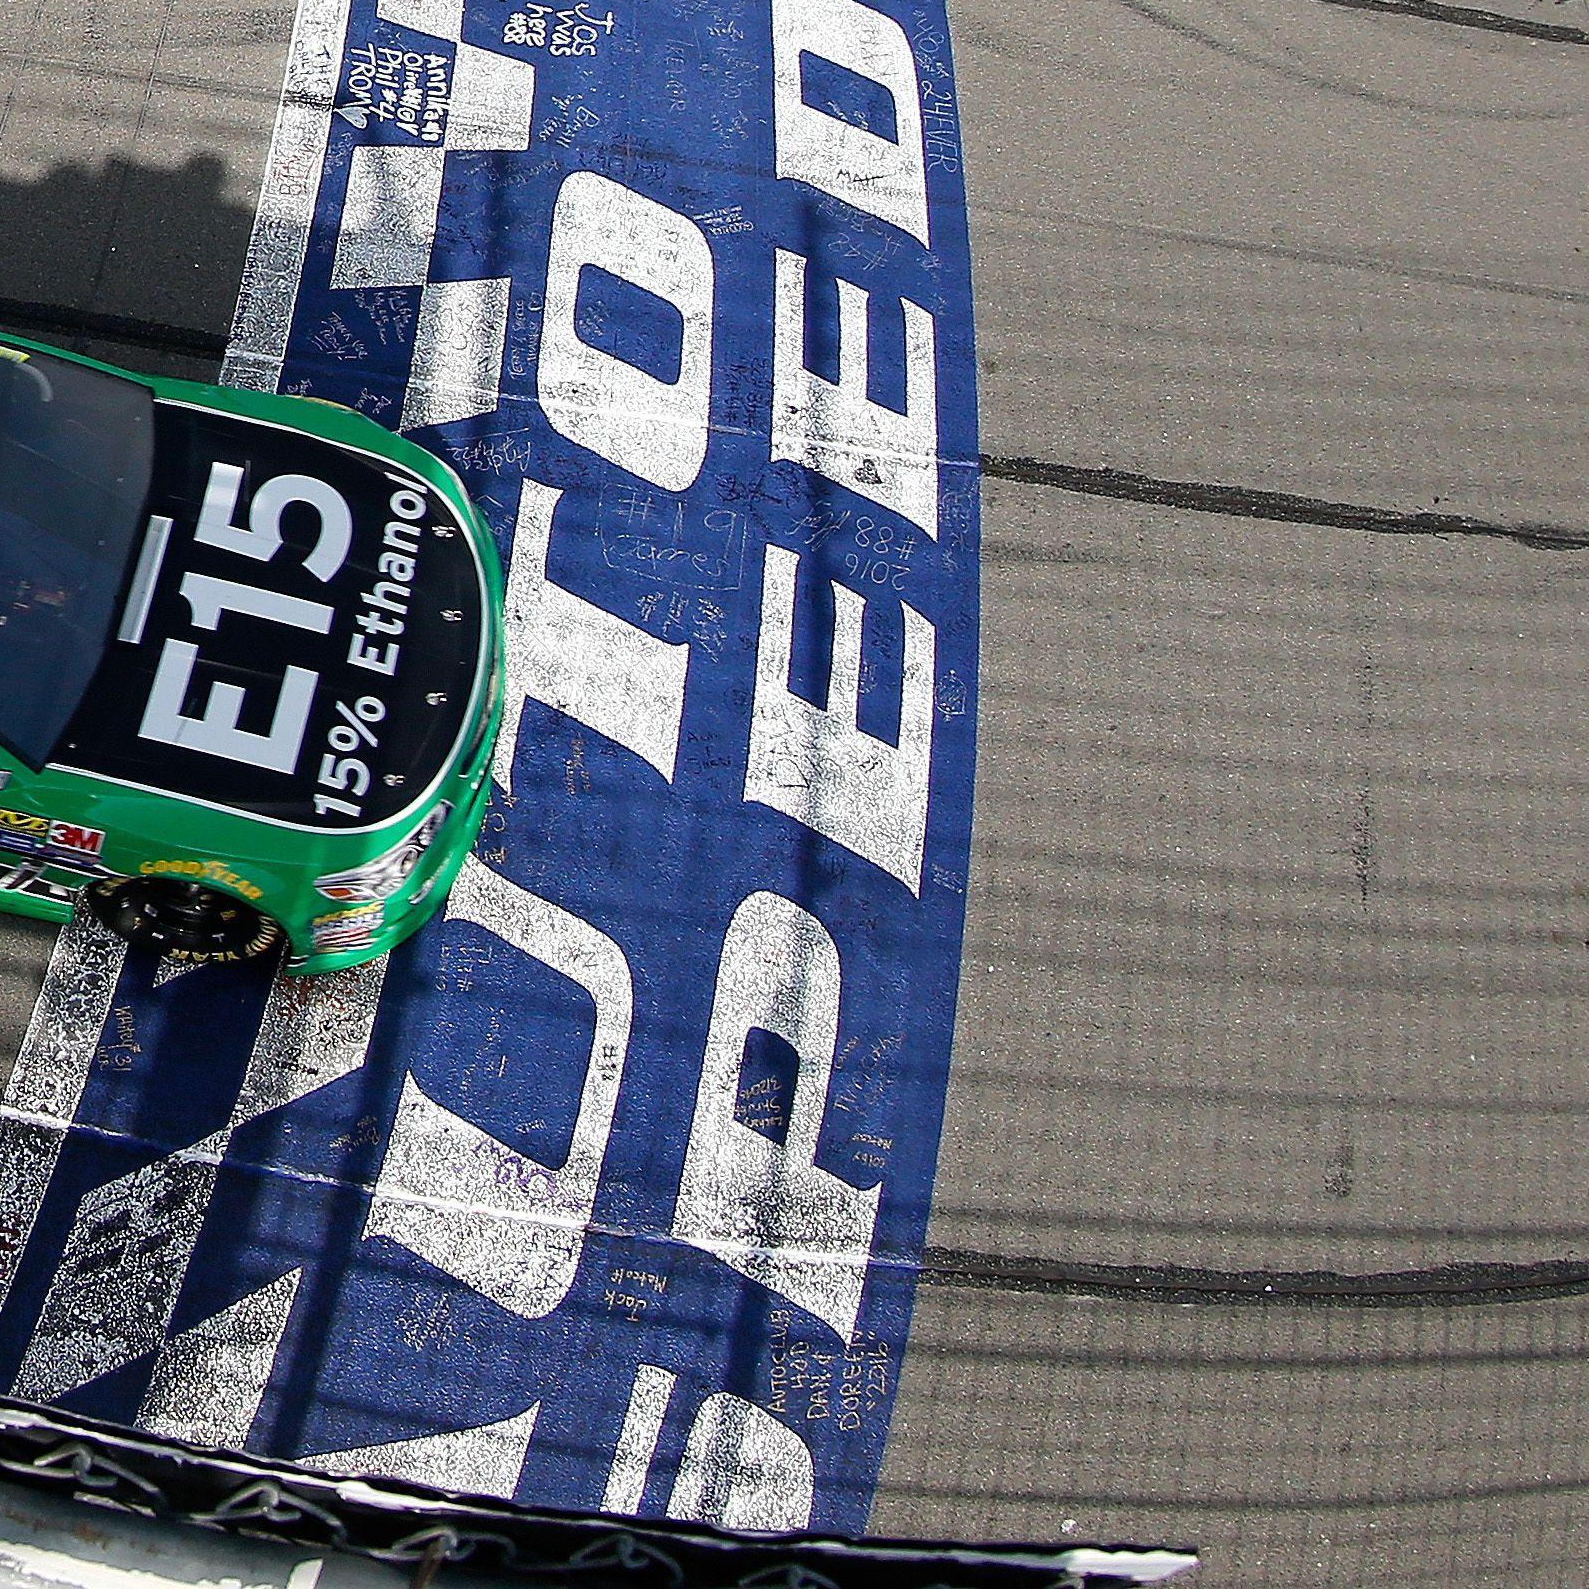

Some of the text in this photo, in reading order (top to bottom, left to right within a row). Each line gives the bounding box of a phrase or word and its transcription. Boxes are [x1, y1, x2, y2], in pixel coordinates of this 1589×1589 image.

[523, 2, 553, 48] here
[549, 8, 575, 57] was
[345, 470, 429, 677] Ethanol
[137, 460, 354, 775] E15
[314, 694, 387, 818] 15%
[50, 823, 100, 853] 3M
[138, 859, 264, 901] GOODYEAR
[603, 1289, 647, 1322] Jack
